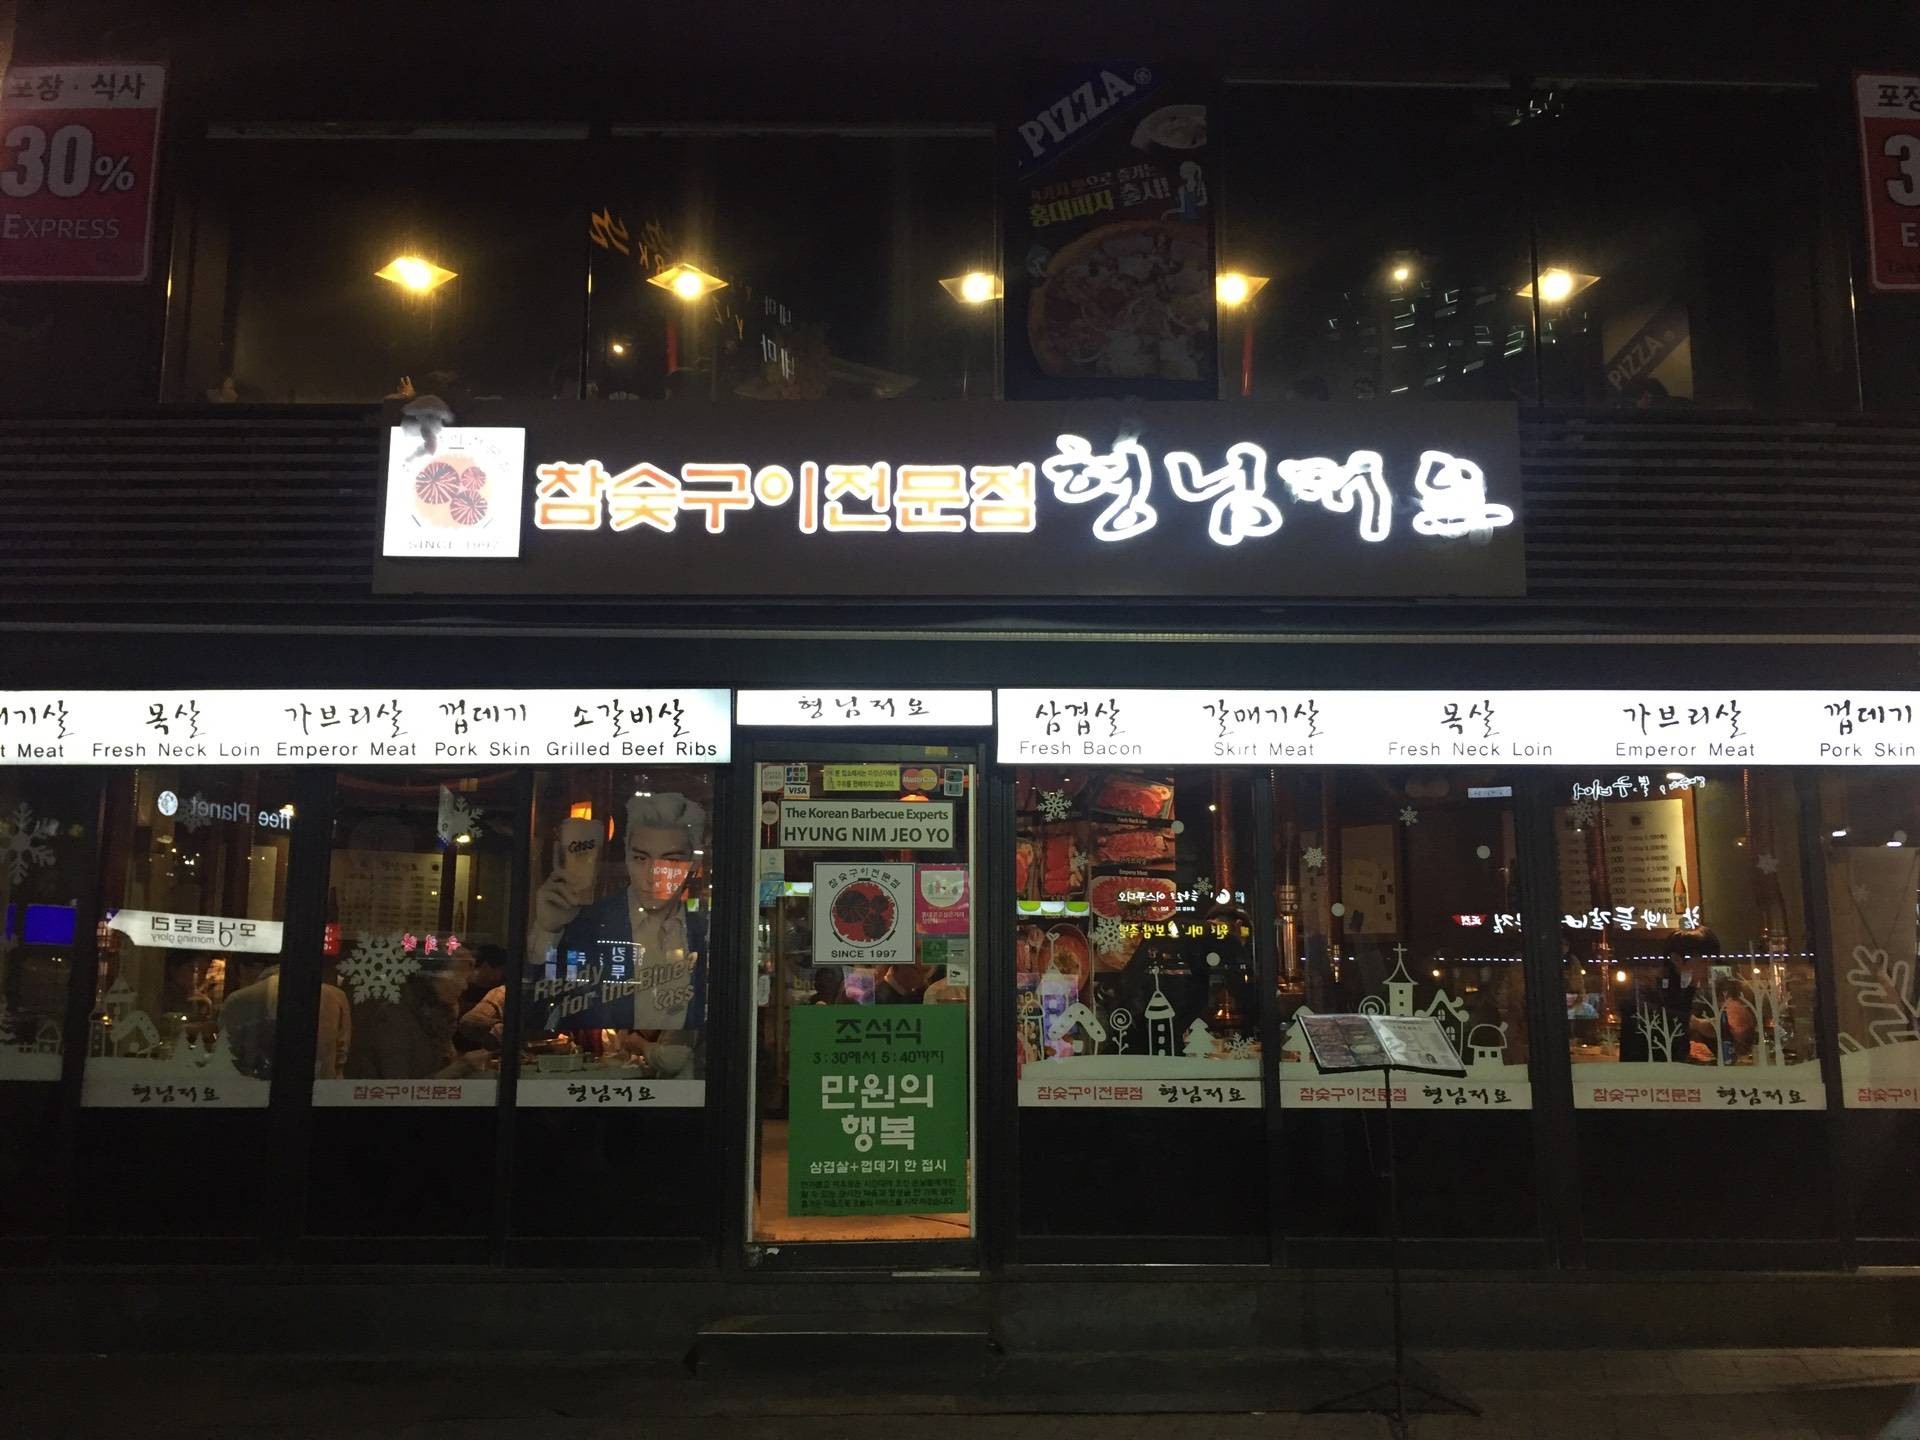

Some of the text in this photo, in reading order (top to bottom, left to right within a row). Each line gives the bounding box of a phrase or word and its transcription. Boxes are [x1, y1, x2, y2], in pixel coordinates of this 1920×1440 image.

[8, 73, 145, 100] 포장 식사
[1018, 70, 1136, 158] PIZZA
[534, 459, 1038, 535] 참숯구이전문점
[146, 700, 204, 738] 목살
[285, 700, 407, 738] 가브리살
[440, 700, 527, 734] 껍데기
[574, 699, 690, 738] 소갈비살
[1036, 699, 1125, 737] 삼겹살
[1203, 699, 1323, 738] 갈매기살
[1441, 700, 1499, 738] 목살
[1623, 700, 1746, 738] 가브리살
[1824, 700, 1912, 735] 껍데기
[17, 744, 64, 758] Meat
[93, 743, 260, 758] Fresh Neck Loin
[277, 742, 416, 760] Emperor Meat
[436, 742, 530, 757] Pork Skin
[547, 741, 717, 757] Grilled Beef Ribs
[1020, 741, 1142, 755] Fresh Bacon
[1214, 742, 1315, 757] Skirt Meat
[1389, 742, 1553, 757] Fresh Neck Loin
[1616, 743, 1755, 759] Emperor Meat
[1821, 743, 1916, 757] Pork Skin
[788, 787, 807, 795] VISA
[785, 807, 807, 819] The
[808, 807, 849, 820] Korean
[851, 807, 905, 820] Barbecue
[906, 808, 949, 823] Experts
[784, 827, 950, 843] HYUNG NIM JEO YO
[831, 949, 897, 958] SINCE 1997
[533, 966, 603, 1003] Ready
[560, 990, 597, 1019] for
[601, 975, 639, 1005] the
[637, 951, 699, 992] Blue?
[653, 982, 695, 1011] Cass
[835, 1018, 922, 1046] 조석식
[352, 1083, 462, 1101] 참숯구이전문점
[822, 1073, 934, 1110] 만원의
[1037, 1086, 1143, 1101] 참숯구이전문점
[1593, 1087, 1701, 1103] 참숯구이전문점
[841, 1114, 915, 1152] 행복
[904, 1159, 917, 1173] 한
[922, 1158, 947, 1173] 접시
